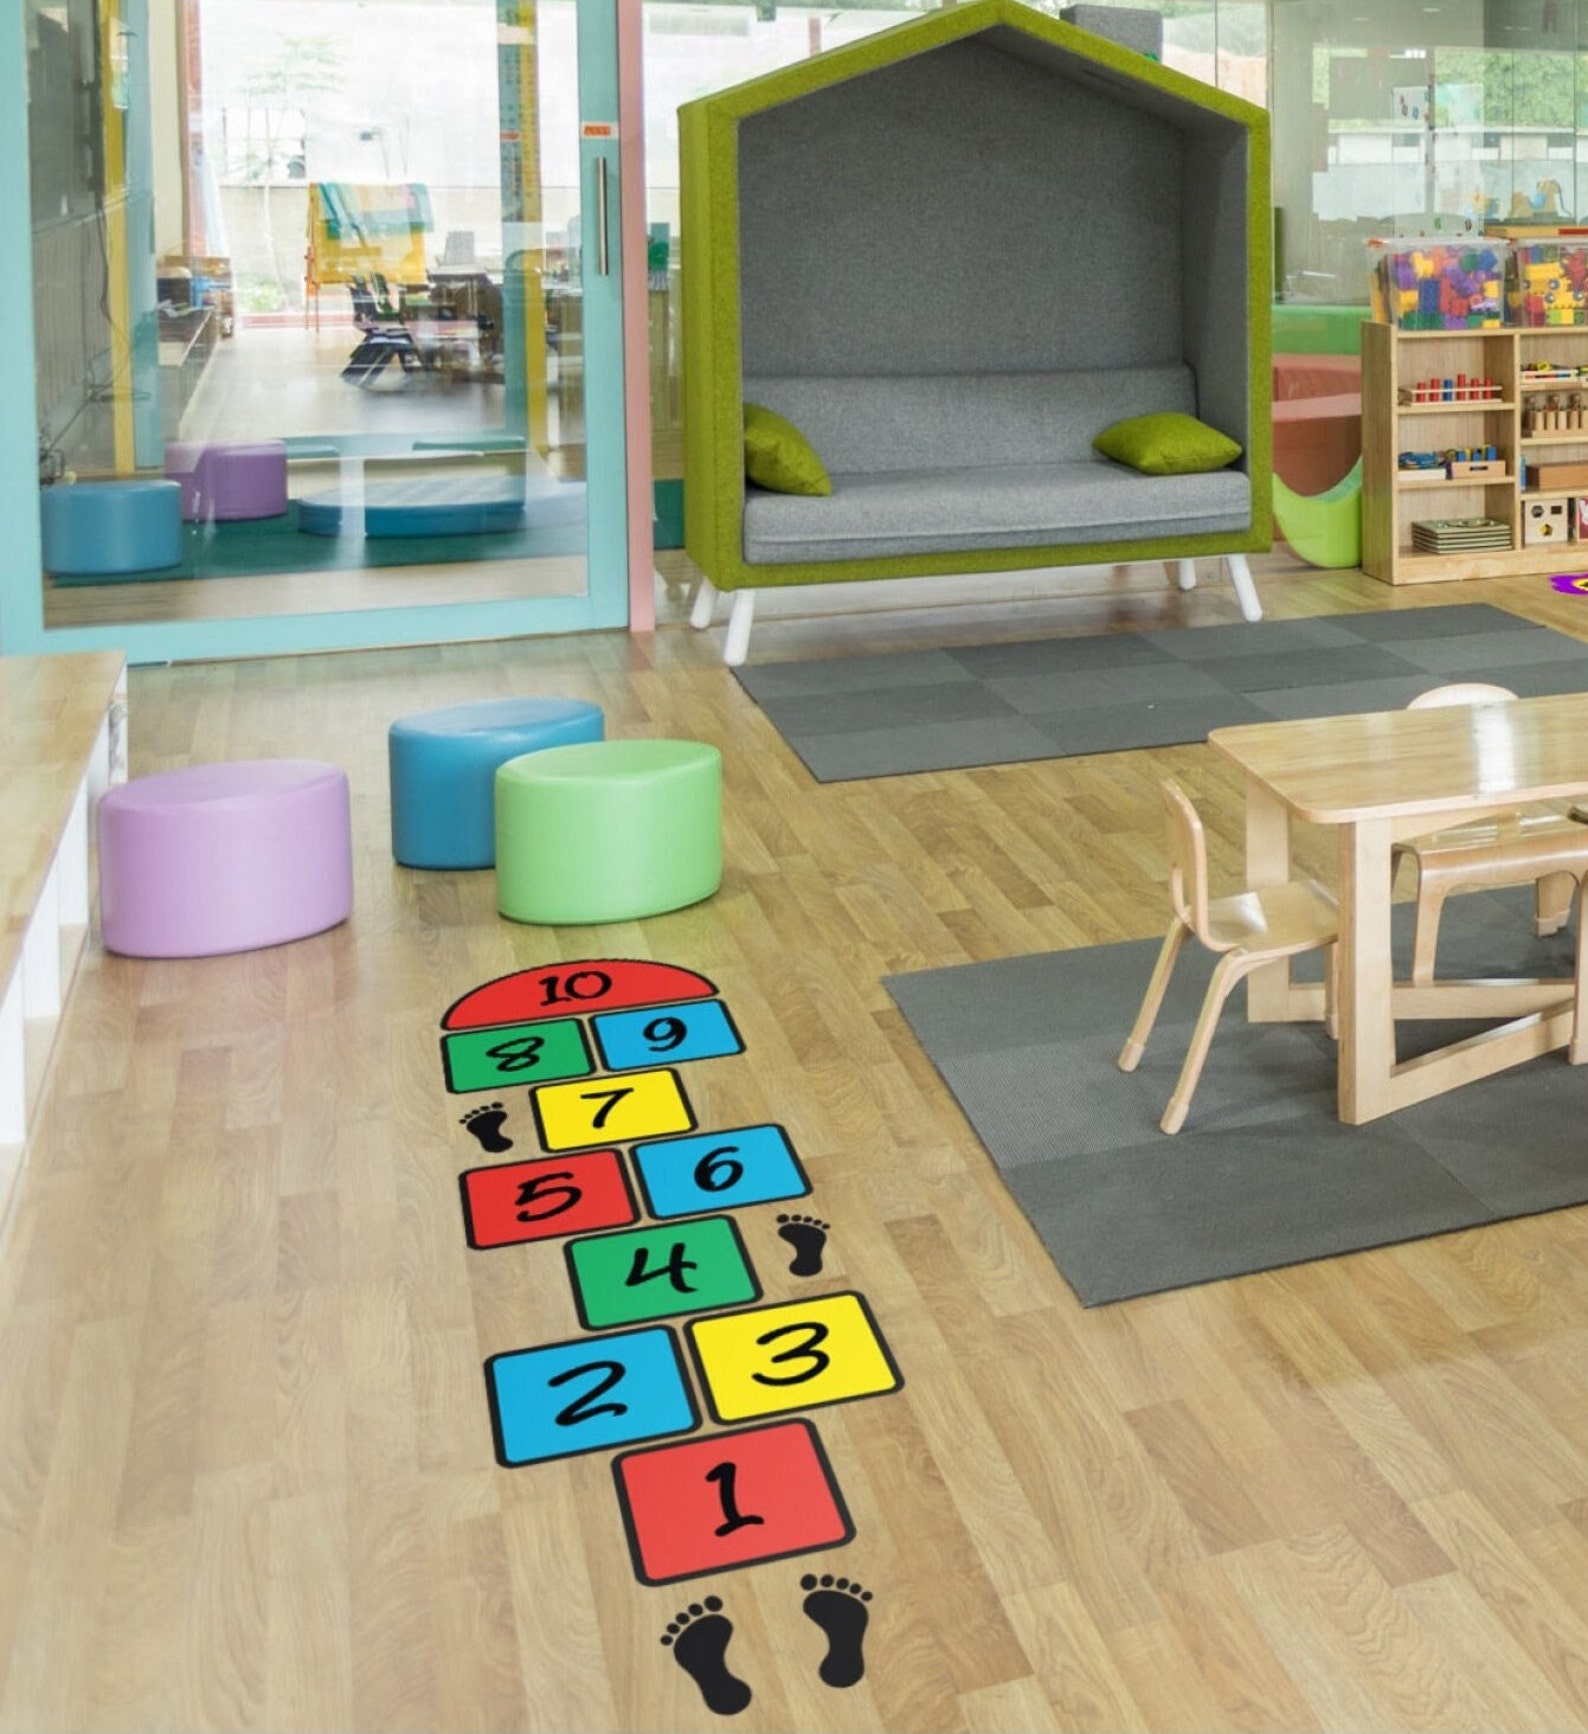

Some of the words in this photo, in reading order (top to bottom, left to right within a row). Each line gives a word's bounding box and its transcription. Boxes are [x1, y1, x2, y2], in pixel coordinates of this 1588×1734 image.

[539, 970, 612, 1006] 10
[485, 1036, 545, 1073] 8
[643, 1017, 687, 1052] 9
[580, 1087, 634, 1129] 7
[693, 1146, 744, 1192] 6
[515, 1171, 582, 1223] 5
[624, 1242, 698, 1294] 4
[751, 1322, 830, 1387] 3
[548, 1360, 628, 1427] 2
[705, 1462, 764, 1537] 1
